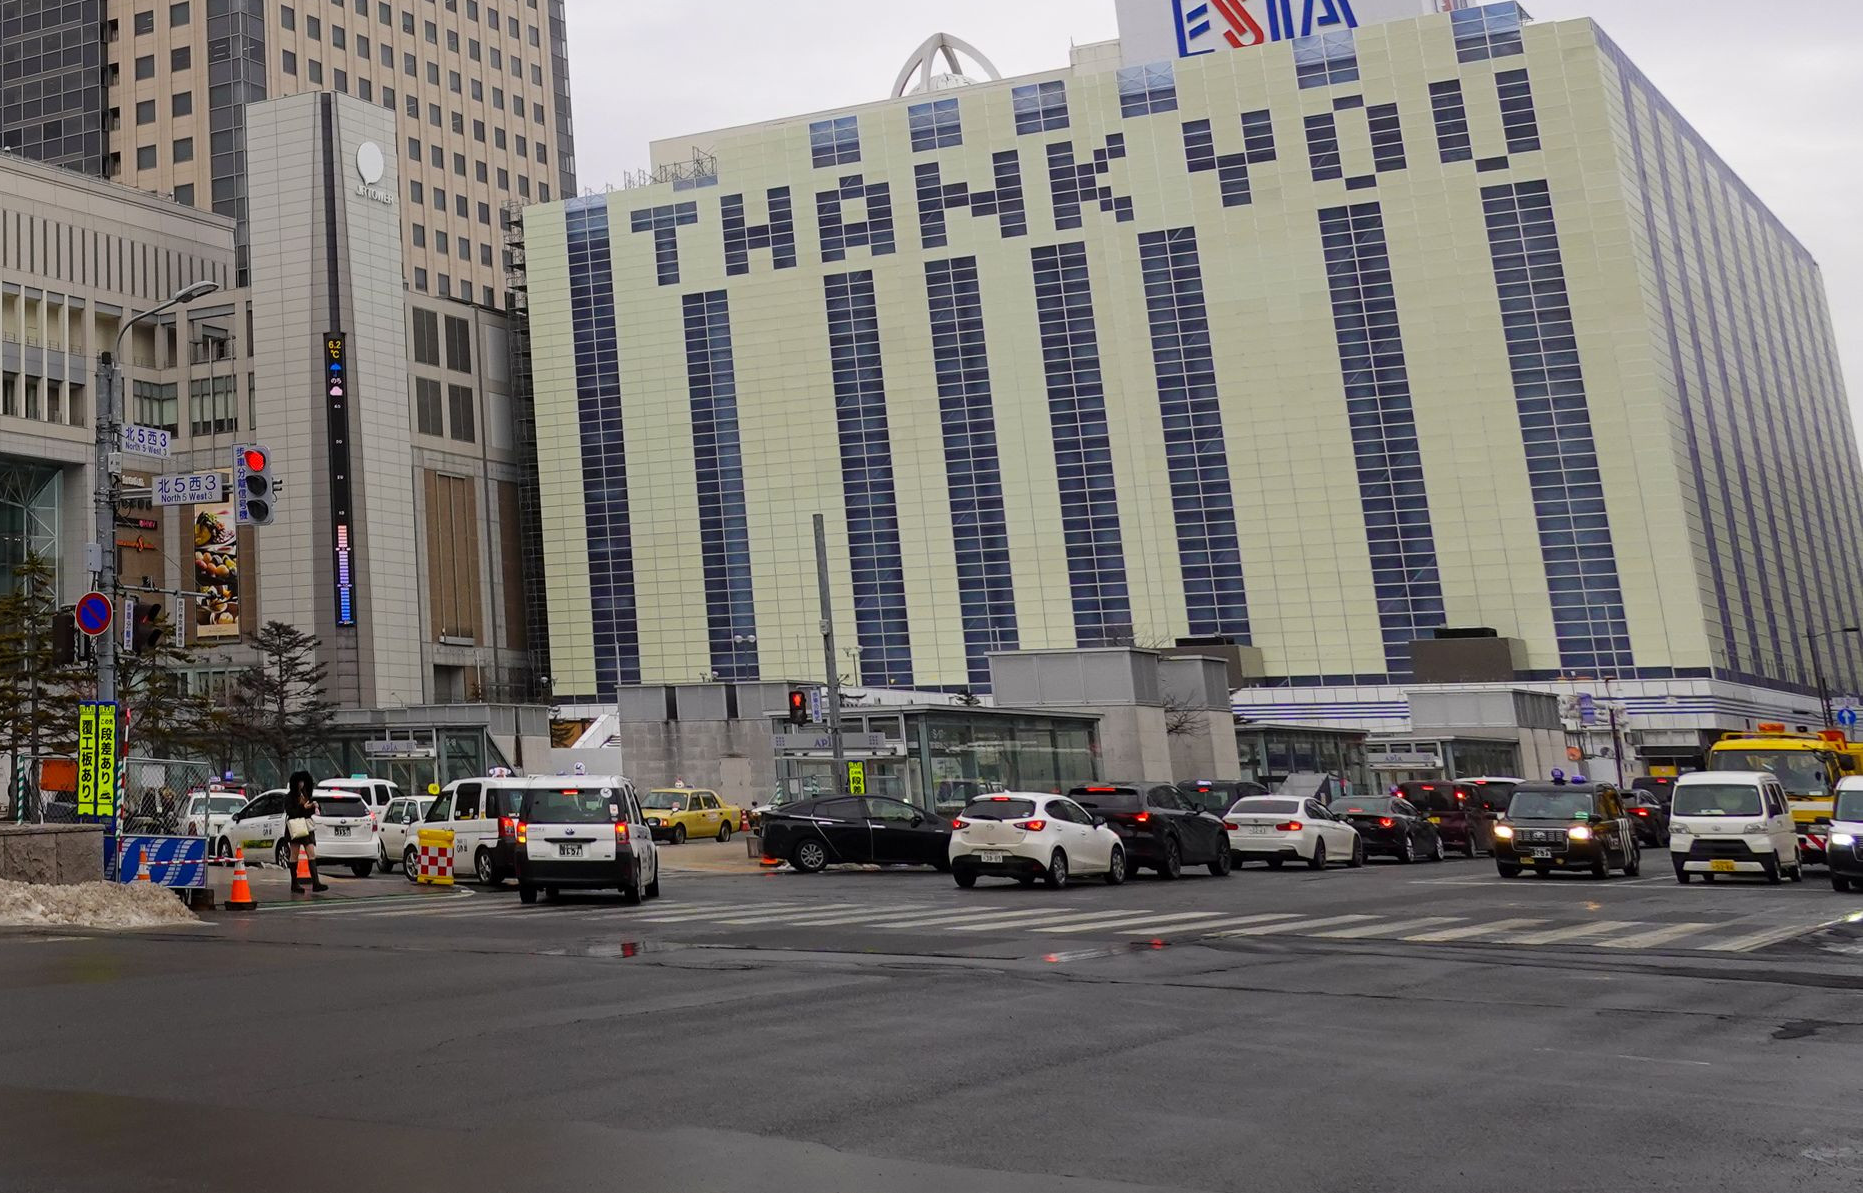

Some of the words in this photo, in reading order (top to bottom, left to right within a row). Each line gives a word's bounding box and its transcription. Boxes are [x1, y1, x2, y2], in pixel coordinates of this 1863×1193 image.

[631, 133, 1133, 286] THANK
[1182, 69, 1542, 208] YOU
[157, 475, 217, 494] 北5西3
[161, 493, 181, 503] North
[188, 491, 207, 501] West
[81, 720, 93, 799] 覆工板あり
[101, 728, 113, 785] 段差あり
